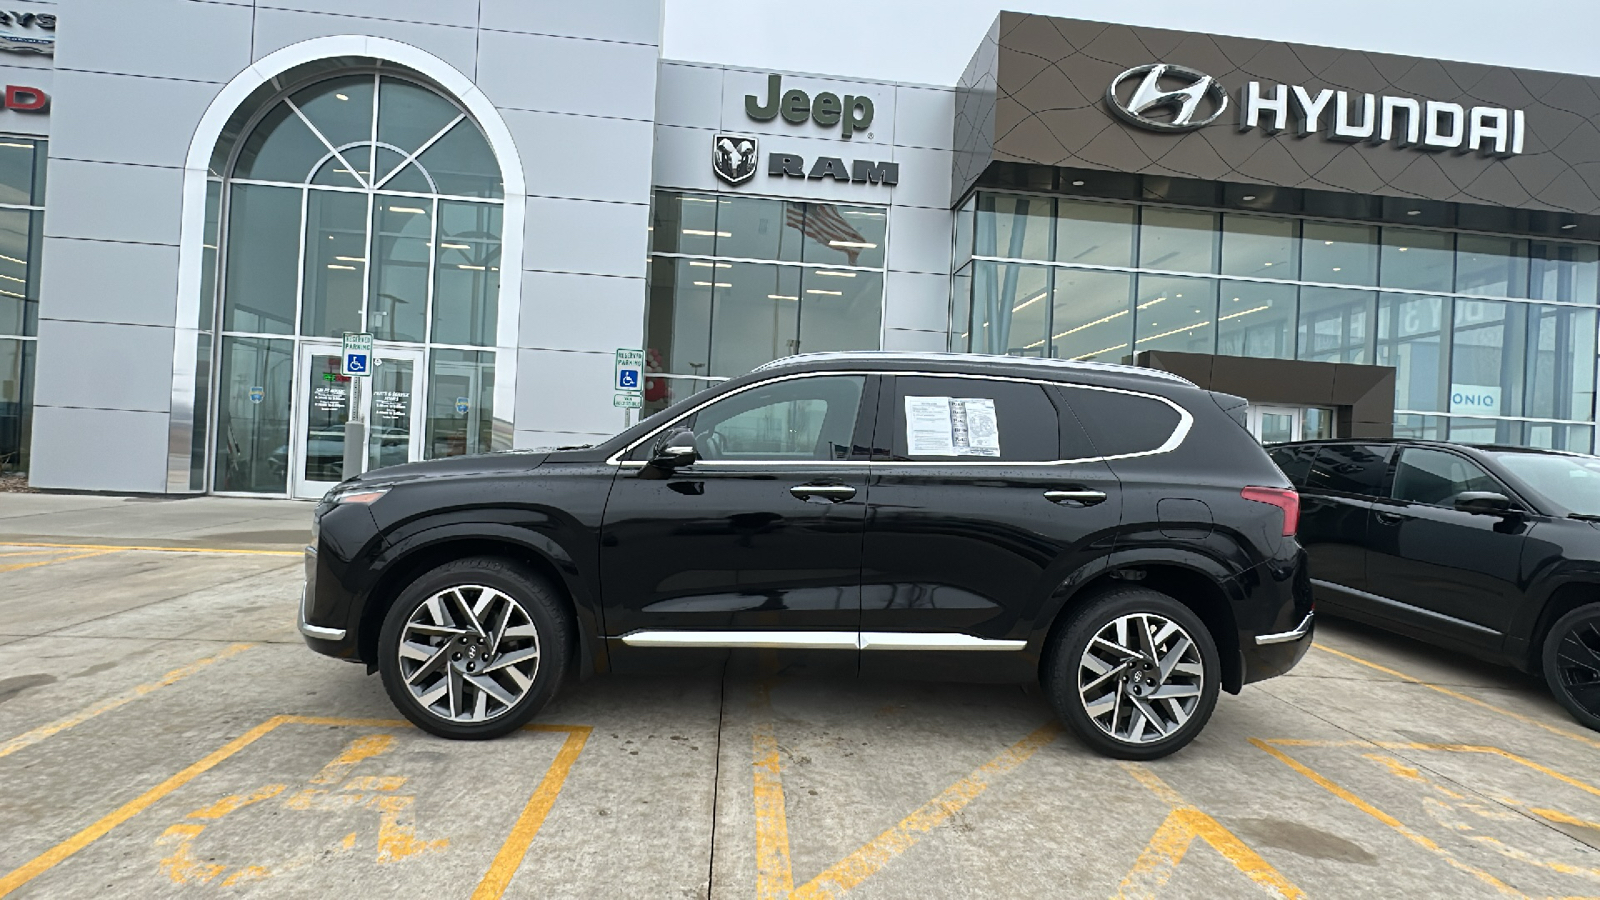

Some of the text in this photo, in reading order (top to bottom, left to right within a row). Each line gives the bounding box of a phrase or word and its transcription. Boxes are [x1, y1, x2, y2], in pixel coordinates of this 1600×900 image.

[5, 85, 46, 110] D
[745, 74, 874, 138] Jeep
[1243, 81, 1525, 155] HYUNDAI
[768, 152, 899, 186] RAM
